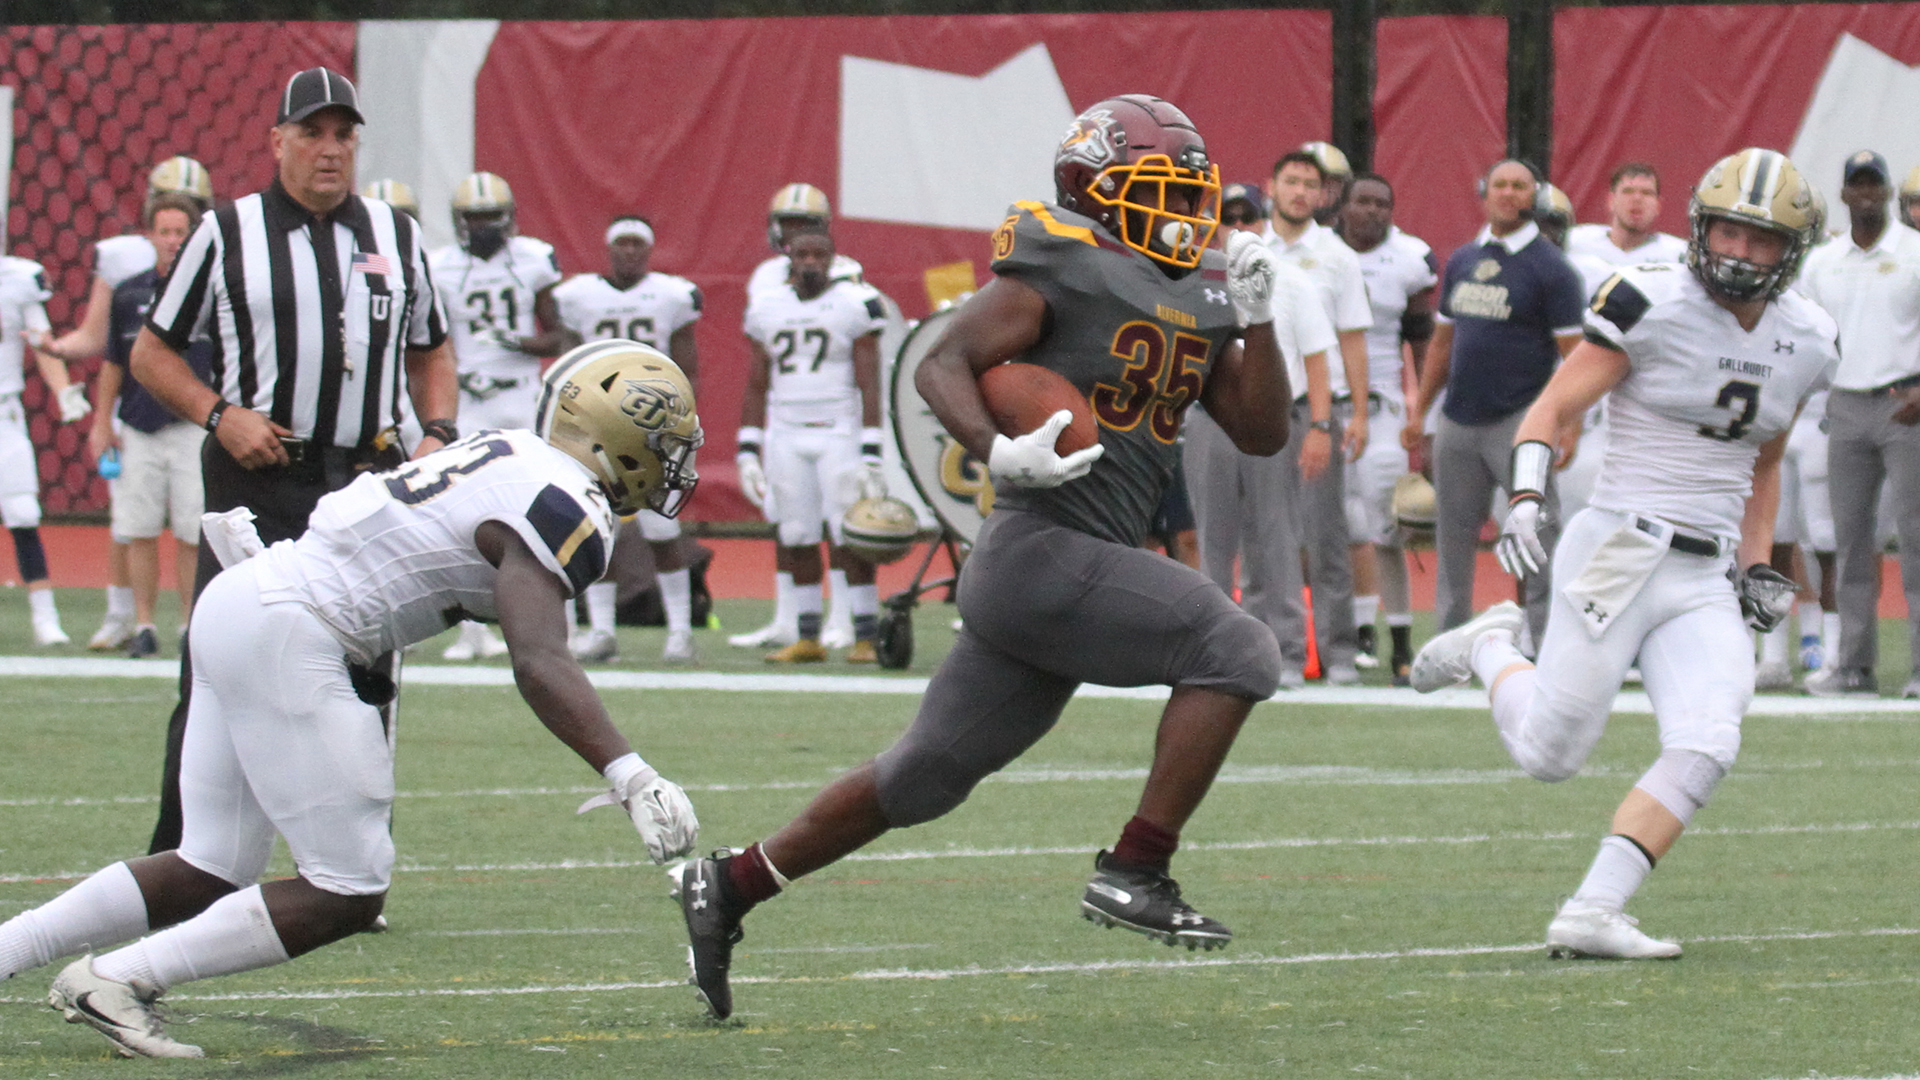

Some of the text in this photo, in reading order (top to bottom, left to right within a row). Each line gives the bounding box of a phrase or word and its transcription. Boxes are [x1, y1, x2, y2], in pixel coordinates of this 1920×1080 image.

[371, 294, 391, 320] U
[466, 287, 518, 335] 31
[773, 328, 831, 374] 27
[1718, 357, 1774, 378] GALLAUDET
[560, 381, 582, 399] 23
[1090, 320, 1212, 444] 35
[1696, 379, 1762, 442] 3
